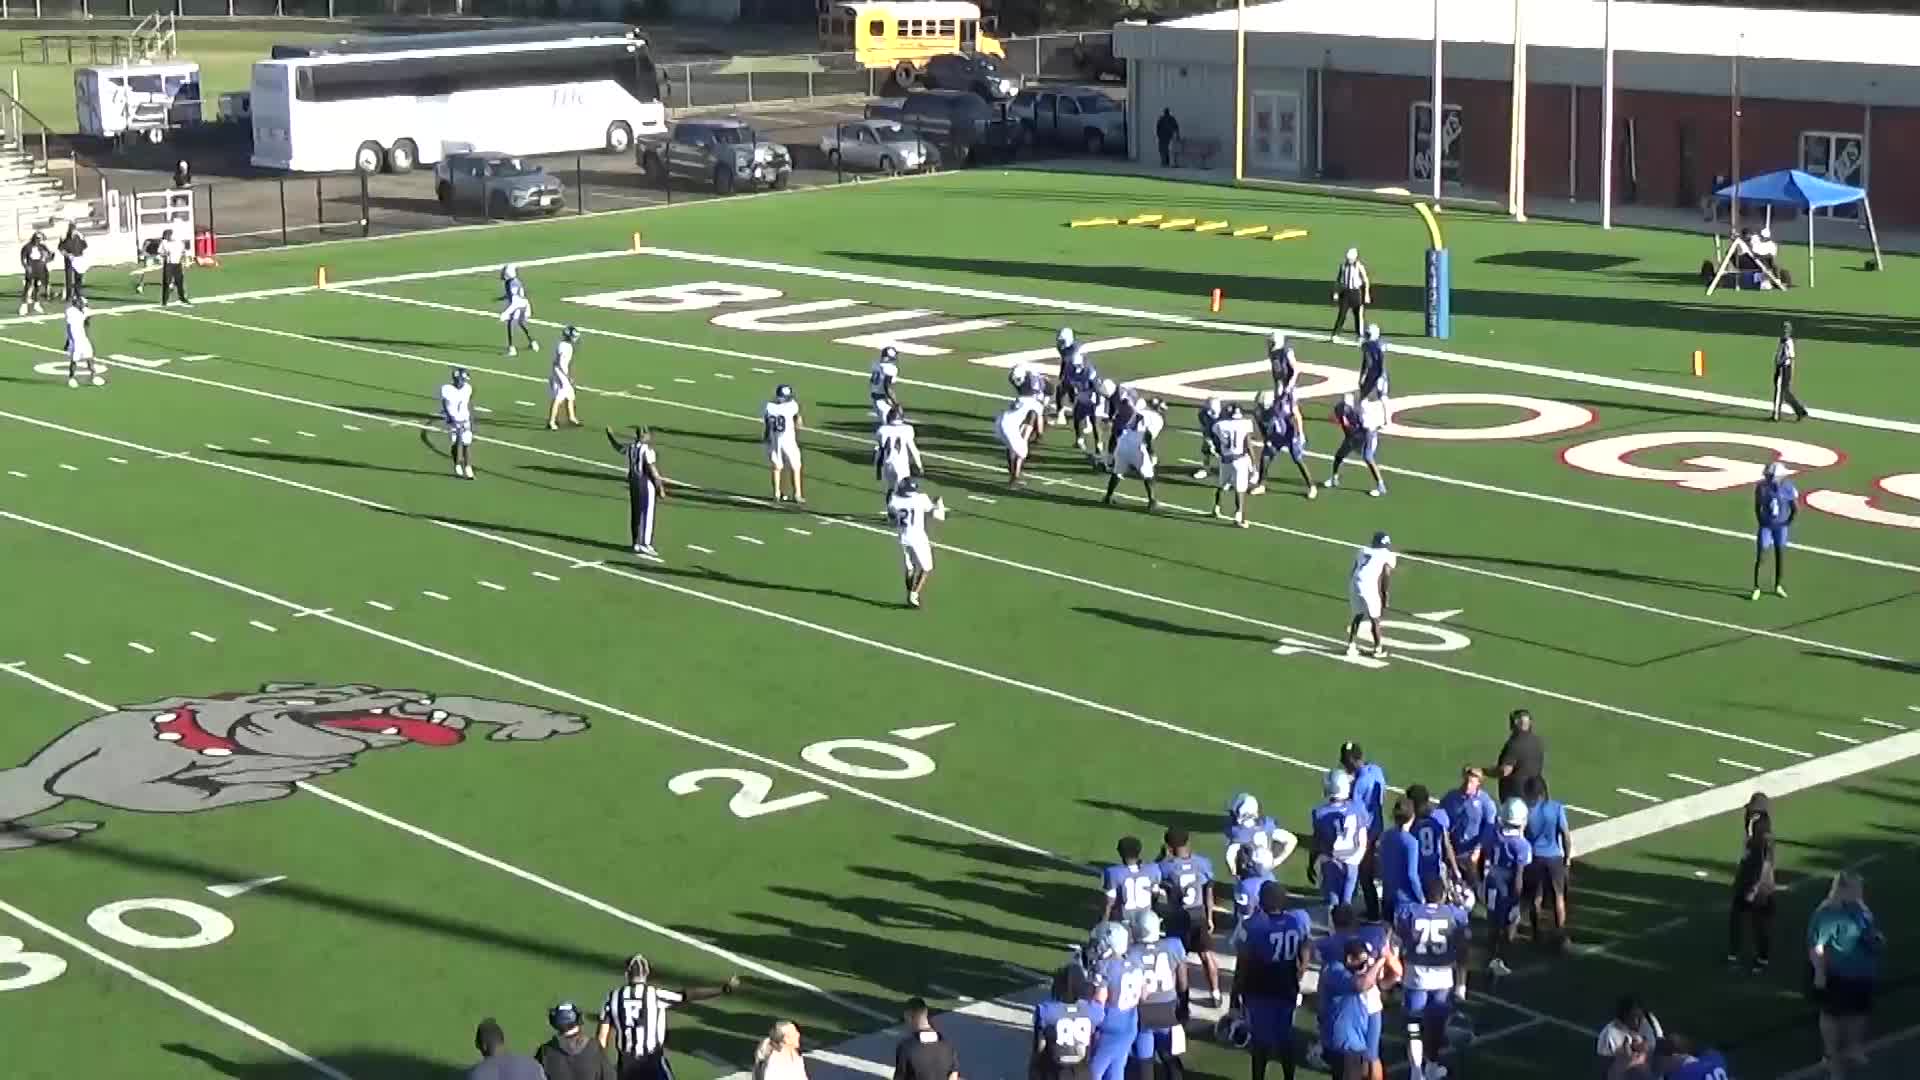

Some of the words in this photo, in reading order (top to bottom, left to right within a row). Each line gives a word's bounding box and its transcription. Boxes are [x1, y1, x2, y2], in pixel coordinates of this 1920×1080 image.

[667, 738, 936, 818] 20
[1123, 875, 1153, 911] 16
[1268, 929, 1299, 962] 70
[1414, 918, 1449, 955] 75
